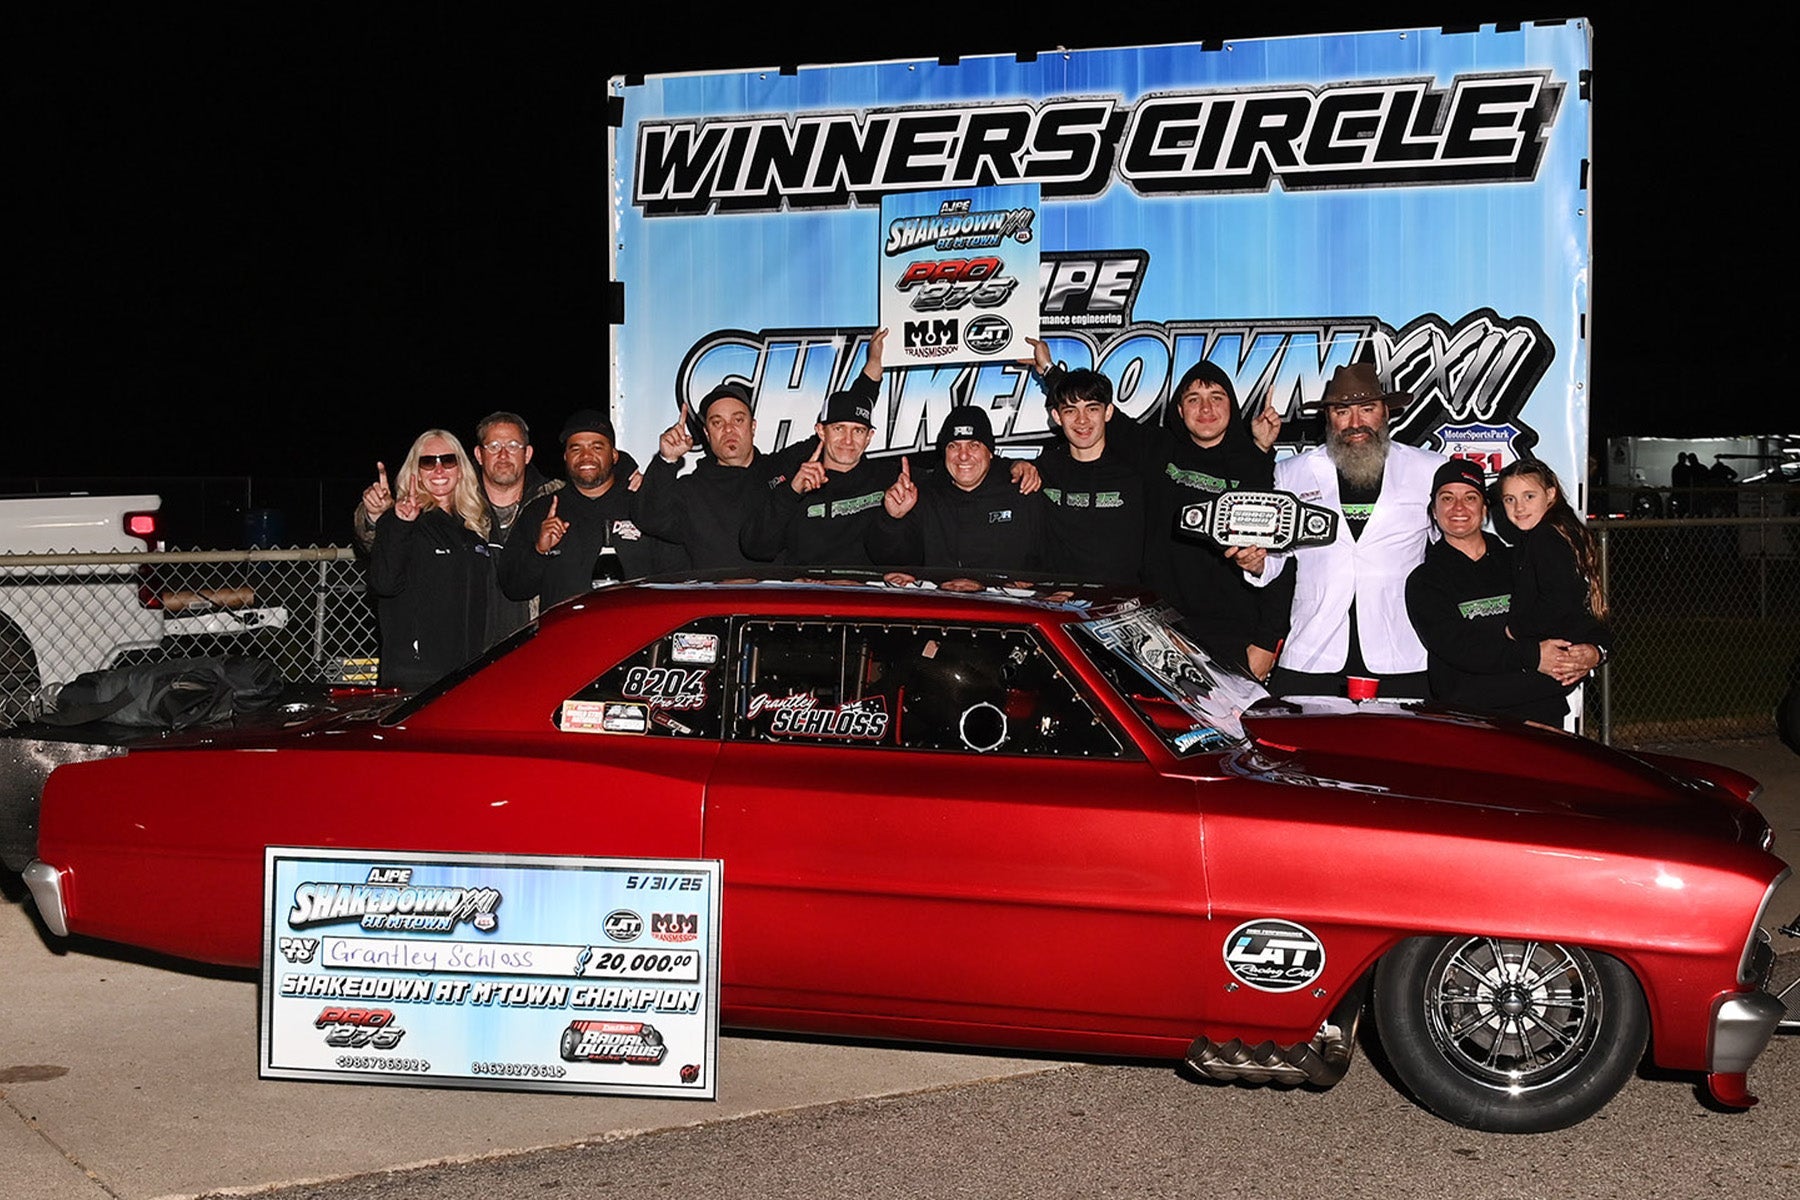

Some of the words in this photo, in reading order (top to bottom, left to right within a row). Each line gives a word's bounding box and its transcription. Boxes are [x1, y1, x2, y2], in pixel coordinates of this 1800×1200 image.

[637, 100, 1118, 212] WINNERS
[1120, 72, 1566, 196] CIRCLE
[941, 200, 970, 212] AJPE
[886, 214, 1004, 252] SHAKEDOWN
[899, 258, 1001, 289] PRO
[912, 277, 1017, 309] 275
[1040, 316, 1070, 325] rmance
[1071, 314, 1122, 325] engineering
[967, 325, 1008, 339] LAT
[905, 345, 959, 358] TRANSMISSION
[1444, 429, 1509, 440] MotorSportsPark
[622, 666, 708, 698] 8204
[648, 694, 674, 708] Pro
[674, 693, 706, 709] 275
[747, 693, 818, 718] Grantley
[771, 708, 888, 738] SCHLOSS
[367, 869, 411, 883] AJPE
[626, 876, 703, 891] 5/31/25
[288, 883, 459, 925] SHAKEDOWN
[362, 914, 386, 927] AT
[280, 938, 319, 952] PAY
[651, 933, 698, 943] TRANSMISSION
[283, 949, 316, 963] TO
[330, 940, 437, 973] Grantley
[448, 945, 534, 970] Schloss
[1225, 936, 1320, 966] LAT
[573, 944, 593, 977] $
[596, 952, 692, 974] 20,000.00
[1234, 963, 1284, 979] Racing
[280, 974, 433, 1003] SHAKEDOWN
[434, 980, 470, 1004] AT
[472, 982, 570, 1009] M'TOWN
[571, 987, 700, 1014] CHAMPION
[315, 1006, 396, 1028] PRO
[324, 1024, 405, 1049] 275
[580, 1030, 643, 1046] RADIAL
[574, 1043, 664, 1058] OUTLAWS
